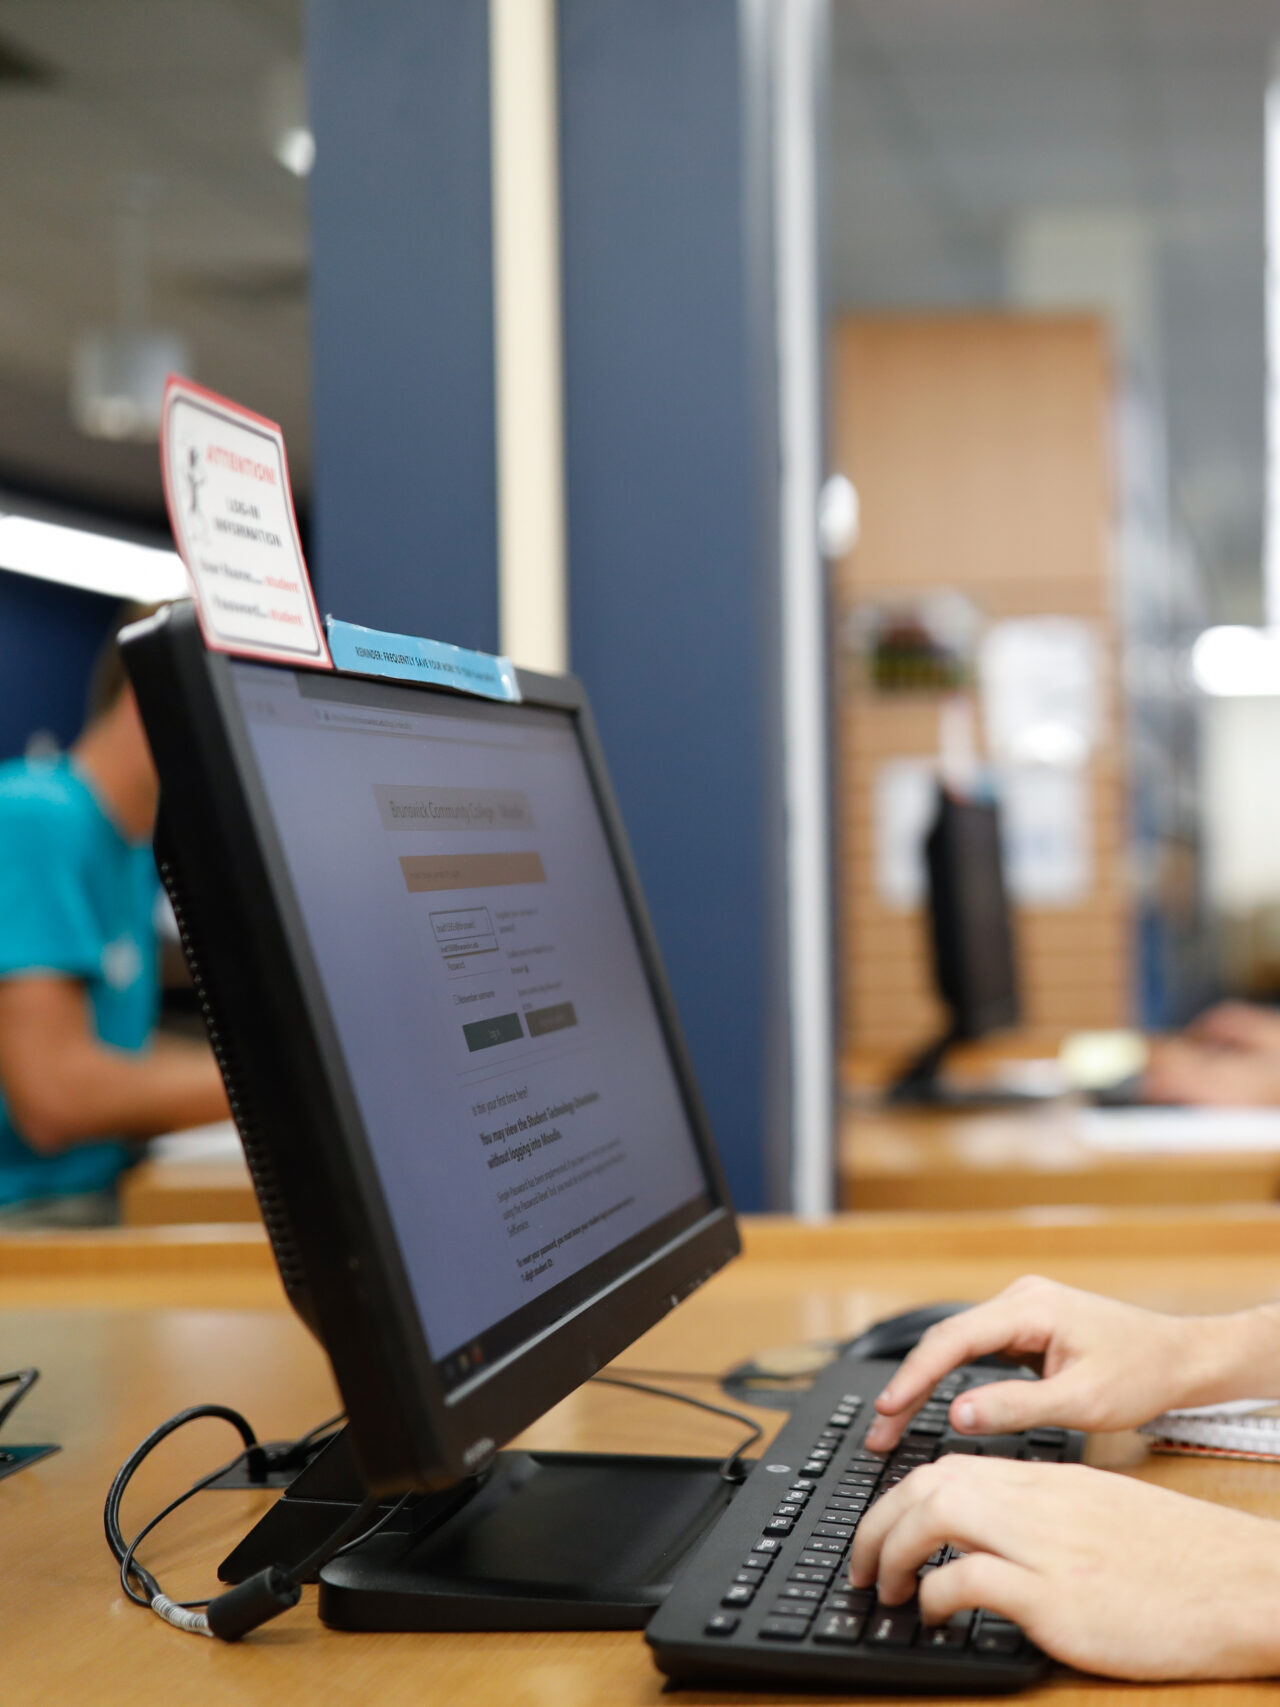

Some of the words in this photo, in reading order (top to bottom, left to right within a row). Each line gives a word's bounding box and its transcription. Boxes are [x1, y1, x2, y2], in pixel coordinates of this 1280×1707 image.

[214, 516, 283, 548] INFORMATION
[383, 651, 415, 667] FREQUENTLY
[415, 656, 429, 670] SAVE
[389, 800, 428, 819] Brunswick
[480, 1132, 493, 1146] You
[492, 1129, 506, 1143] may
[504, 1122, 519, 1137] view
[517, 1117, 529, 1132] the
[526, 1110, 549, 1129] Student
[487, 1150, 511, 1169] without
[508, 1142, 533, 1162] logging
[529, 1136, 543, 1152] into
